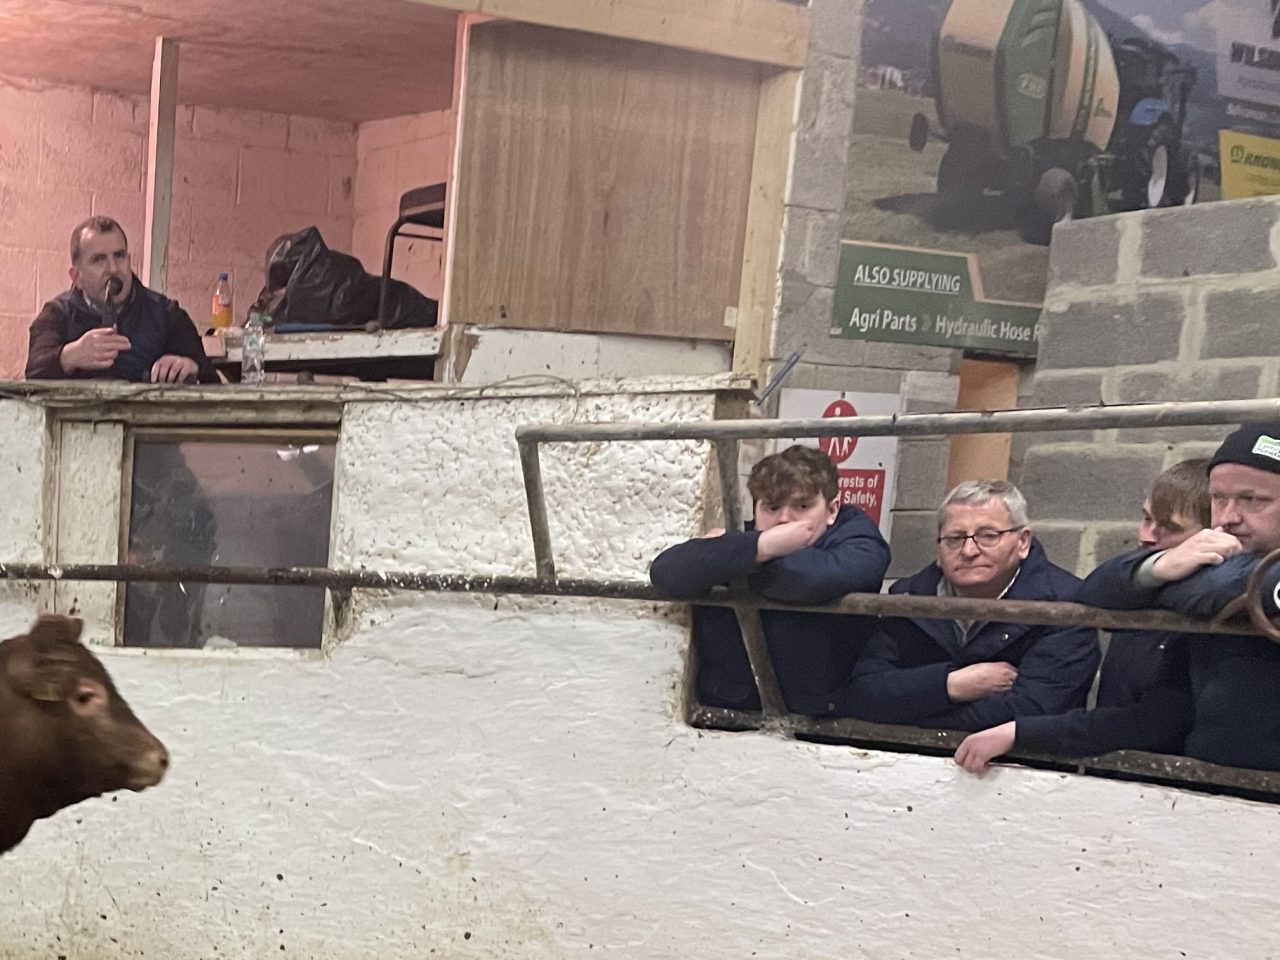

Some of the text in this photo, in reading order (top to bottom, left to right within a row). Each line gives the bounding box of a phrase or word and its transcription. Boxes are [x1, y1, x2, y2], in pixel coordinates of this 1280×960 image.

[854, 265, 961, 292] ALSO SUPPLYING
[849, 307, 881, 333] Agri
[882, 309, 918, 332] Parts
[935, 314, 998, 338] Hydraulic
[1000, 321, 1031, 341] Hose
[867, 473, 879, 488] of
[844, 490, 876, 507] Safety,
